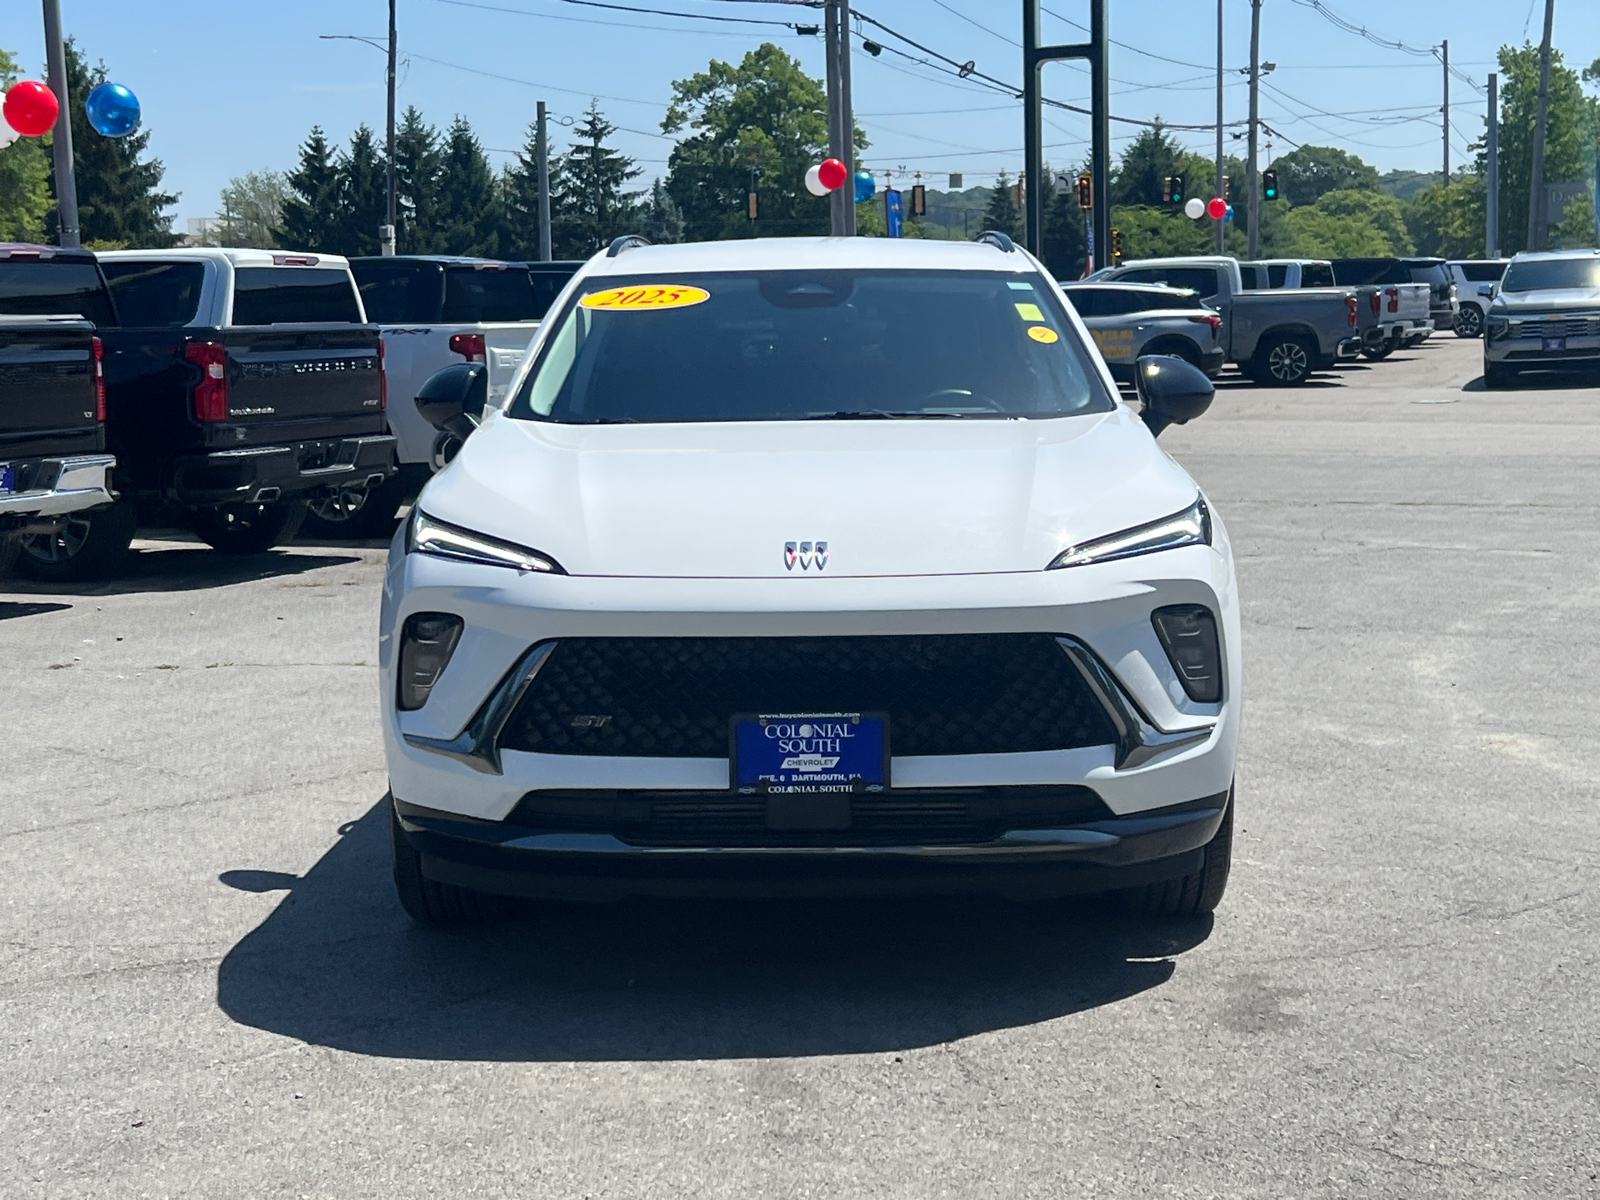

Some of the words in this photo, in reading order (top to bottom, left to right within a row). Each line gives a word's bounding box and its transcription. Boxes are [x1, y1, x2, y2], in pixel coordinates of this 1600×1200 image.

[596, 289, 689, 306] 2025
[764, 723, 855, 739] COLONIAL
[778, 738, 841, 754] SOUTH
[786, 758, 835, 767] CHEVROLET
[768, 785, 818, 794] COLONIAL
[819, 784, 853, 793] SOUTH
